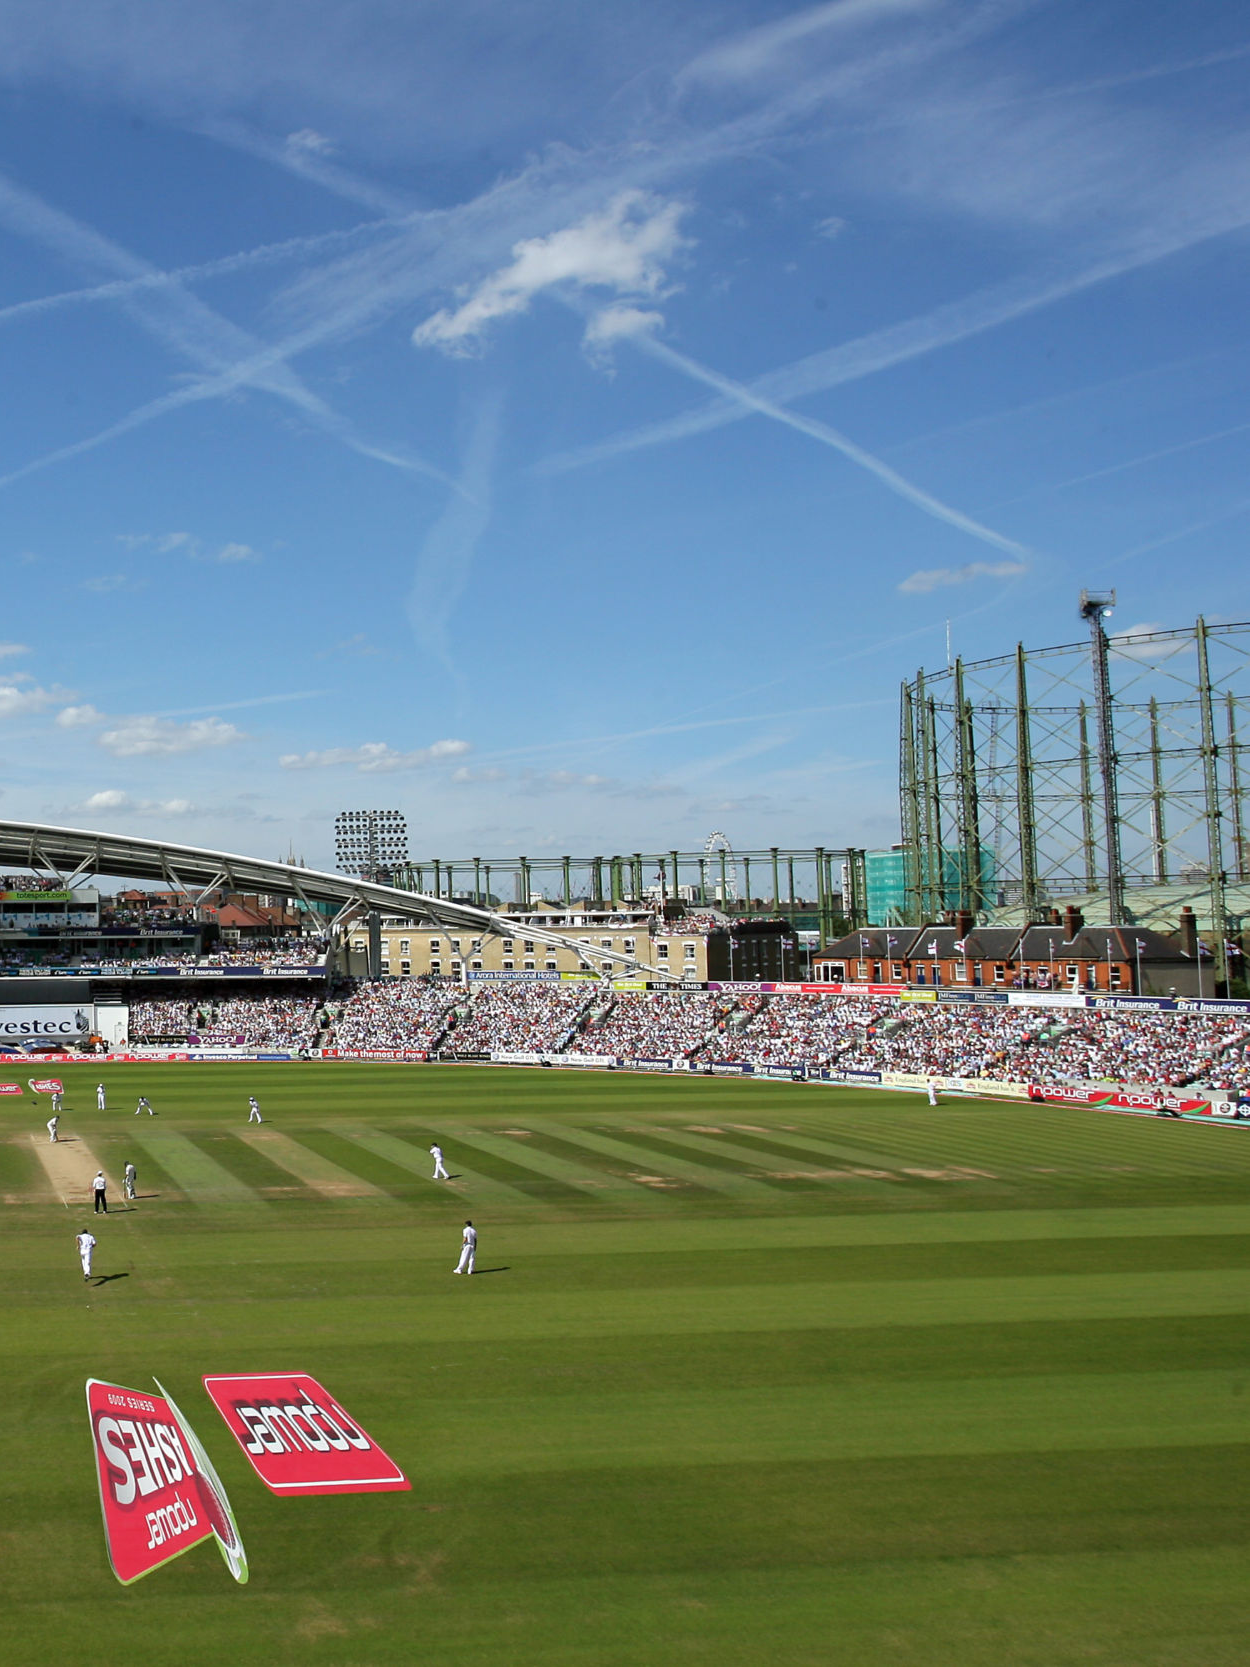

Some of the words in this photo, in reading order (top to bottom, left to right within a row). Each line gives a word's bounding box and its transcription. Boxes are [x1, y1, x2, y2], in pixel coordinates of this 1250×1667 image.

[718, 983, 762, 992] YAHOO!
[1095, 999, 1115, 1008] Brit
[1116, 1000, 1160, 1009] Insurance
[1177, 1002, 1199, 1011] Brit
[1200, 1002, 1248, 1013] Insurance
[338, 1049, 358, 1057] Make
[638, 1060, 668, 1068] Insurance
[696, 1062, 711, 1070] Brit
[712, 1063, 742, 1072] Insurance
[754, 1066, 768, 1074] Brit
[830, 1071, 845, 1079] Brit
[846, 1072, 880, 1082] Insurance
[1033, 1086, 1094, 1099] npower
[1118, 1094, 1188, 1108] npower
[108, 1393, 127, 1406] 2009
[126, 1398, 156, 1412] SERIES
[236, 1389, 371, 1454] npower
[98, 1416, 194, 1505] ASHES
[146, 1491, 198, 1550] npower
